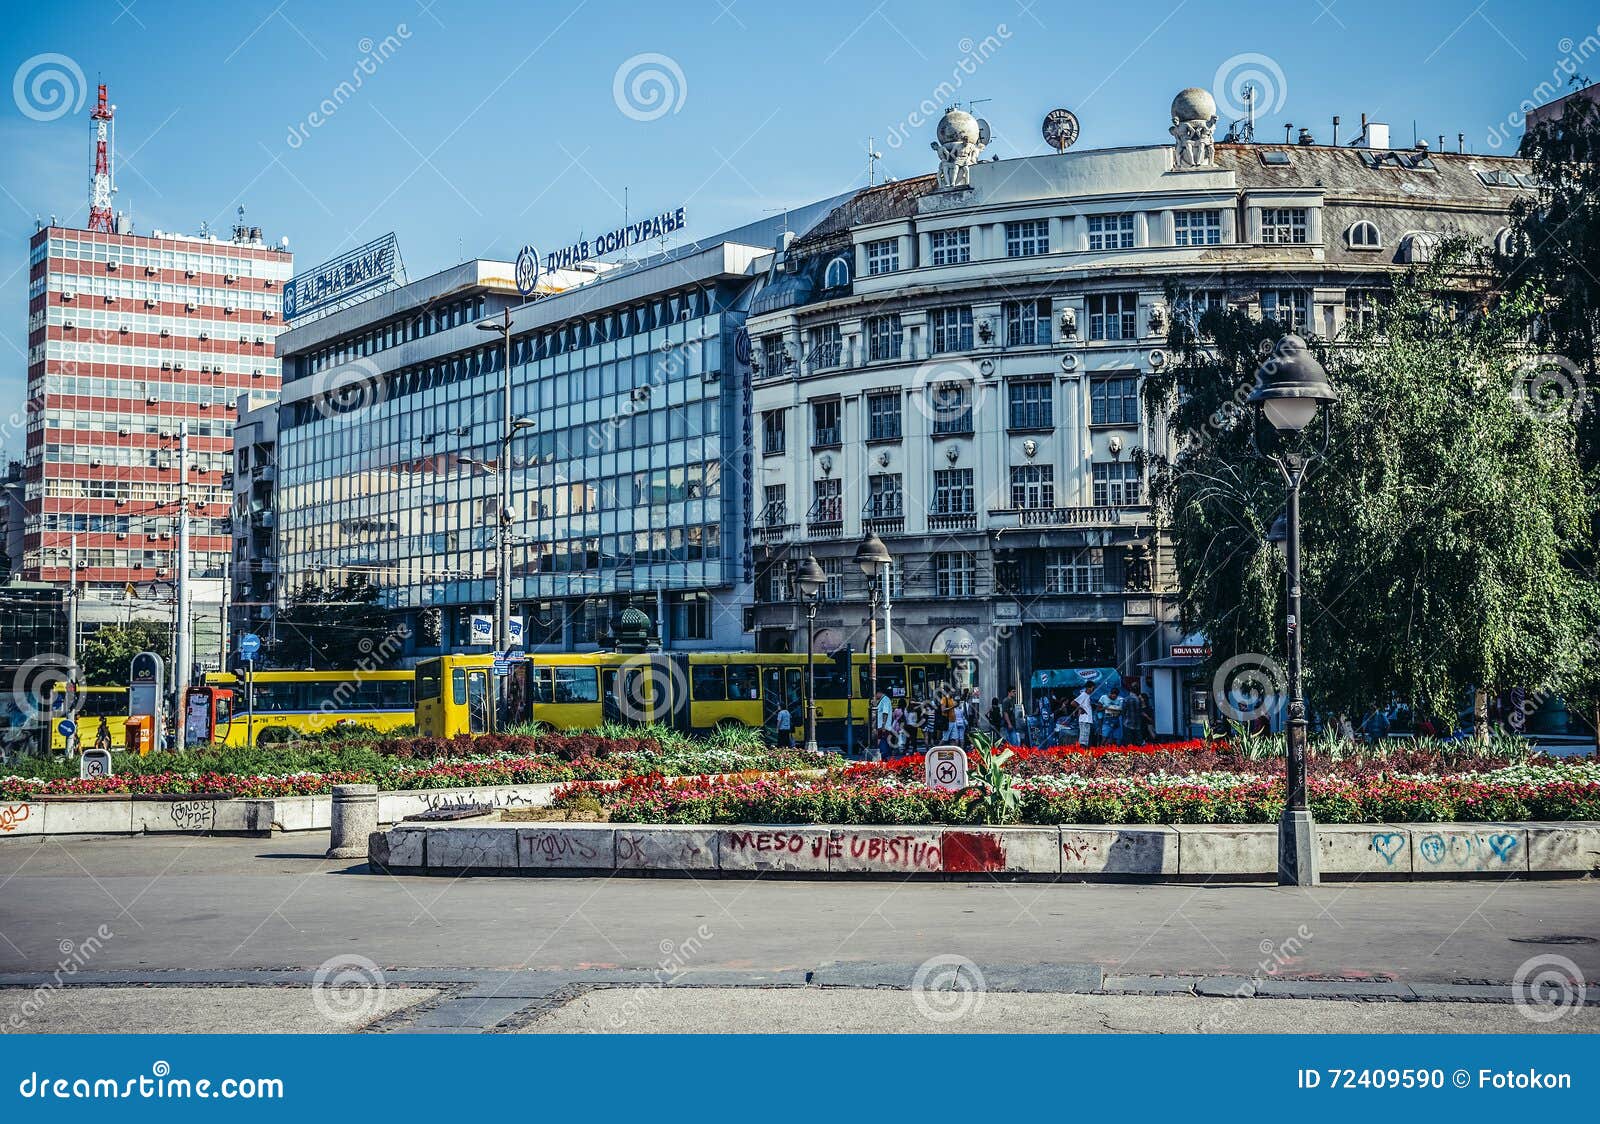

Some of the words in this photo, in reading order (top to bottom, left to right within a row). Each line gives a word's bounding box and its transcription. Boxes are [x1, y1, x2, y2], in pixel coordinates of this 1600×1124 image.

[547, 240, 589, 276] ДУНАВ
[595, 206, 687, 256] ОСИГУРАЊЕ
[302, 268, 342, 306] ALPHA
[344, 248, 387, 288] BANK
[730, 831, 804, 853] MESO
